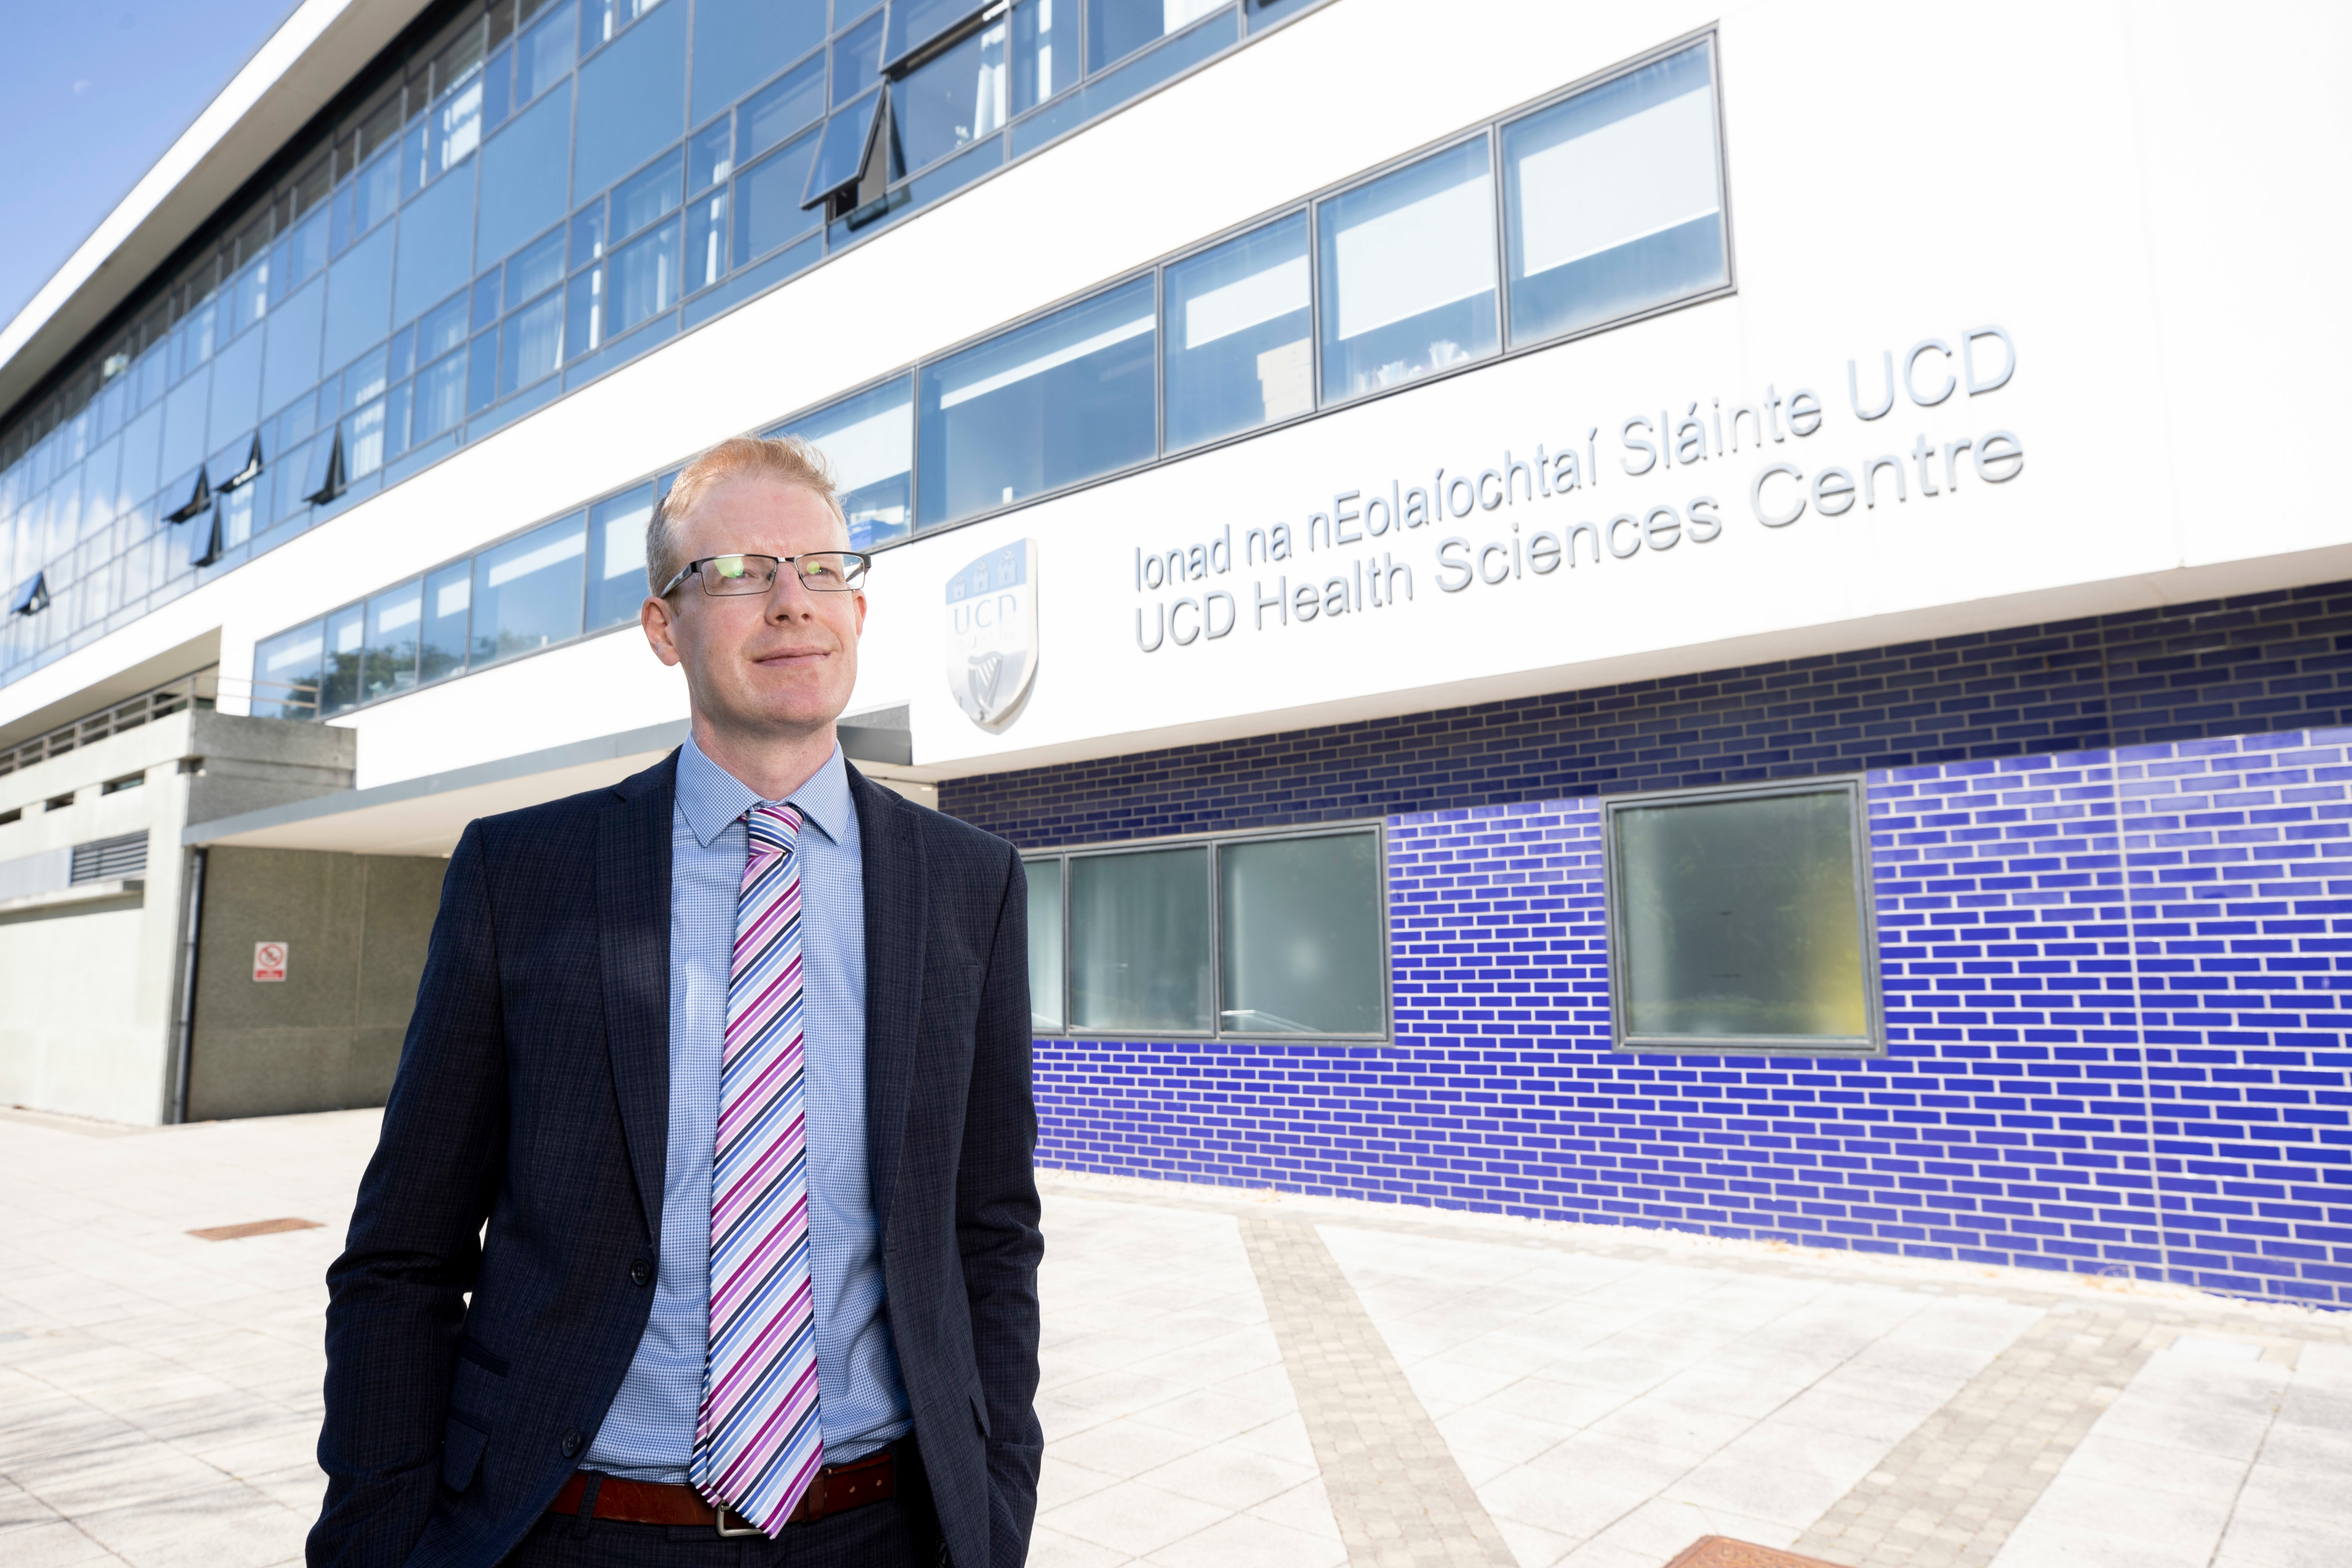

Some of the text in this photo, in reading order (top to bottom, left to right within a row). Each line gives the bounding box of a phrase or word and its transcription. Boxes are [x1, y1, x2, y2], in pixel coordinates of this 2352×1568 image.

[1135, 325, 2016, 593] Ionad na nEolaíochtaí Sláinte UCD
[1136, 430, 2024, 653] UCD Health Sciences Centre
[954, 594, 1017, 635] UCD
